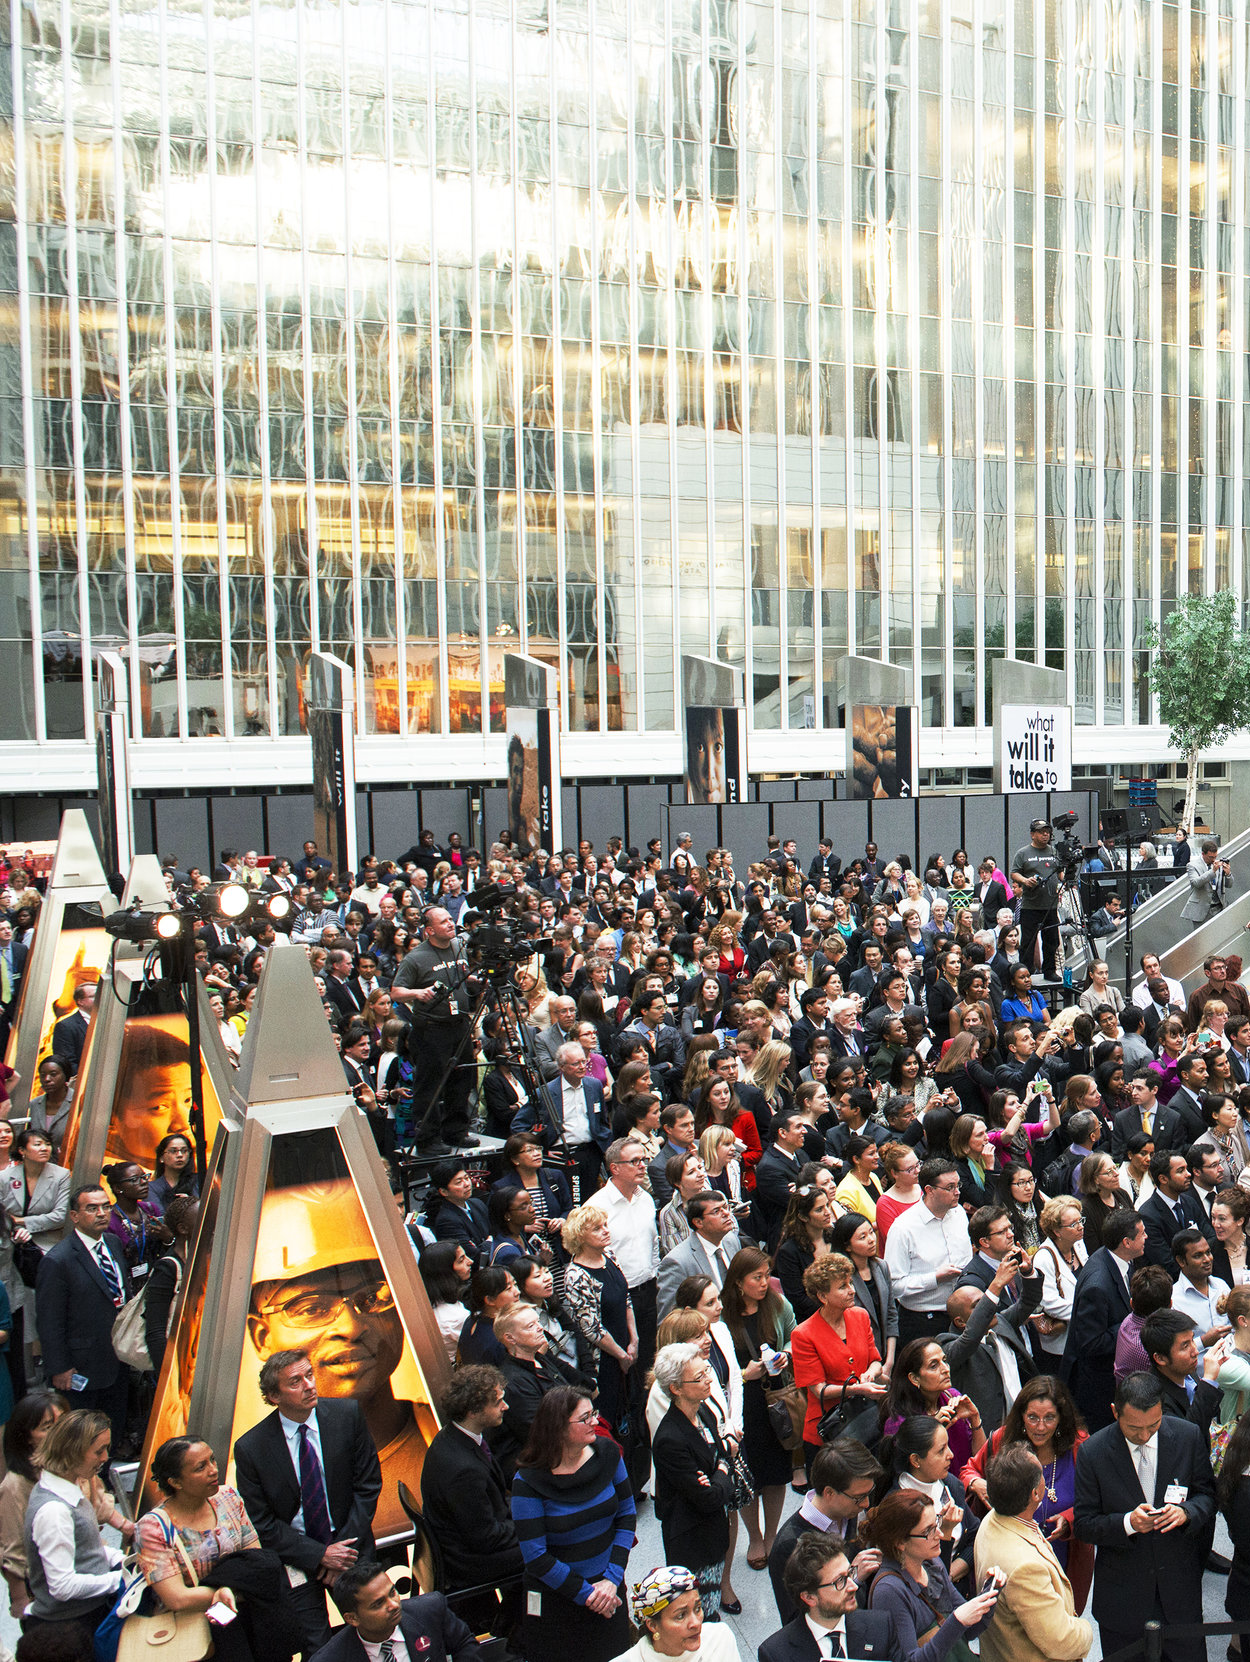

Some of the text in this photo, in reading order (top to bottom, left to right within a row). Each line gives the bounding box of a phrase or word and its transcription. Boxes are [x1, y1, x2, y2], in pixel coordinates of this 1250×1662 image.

[1026, 710, 1055, 732] what
[1007, 732, 1055, 763] will it
[727, 778, 737, 803] nd
[1009, 761, 1058, 791] take to
[541, 785, 550, 832] take
[571, 1175, 581, 1203] SPIDER
